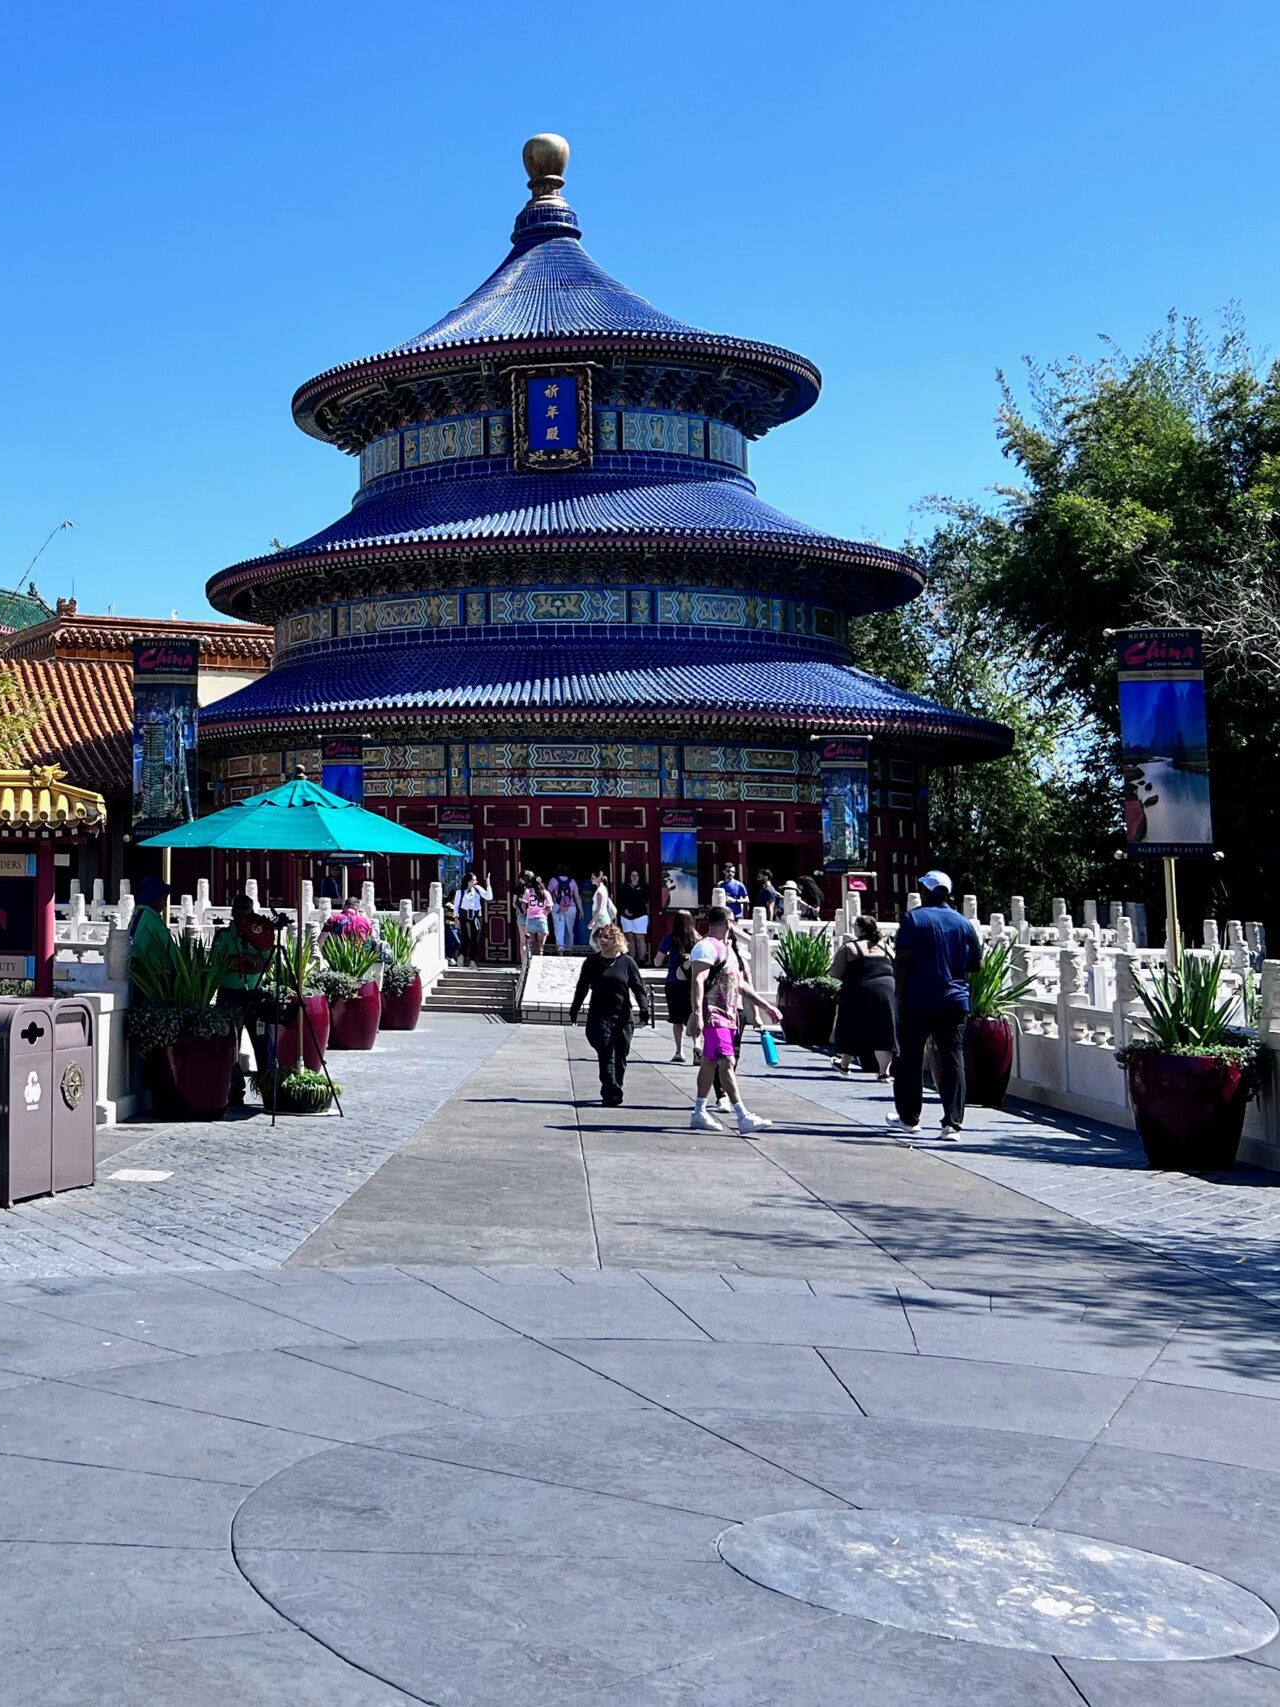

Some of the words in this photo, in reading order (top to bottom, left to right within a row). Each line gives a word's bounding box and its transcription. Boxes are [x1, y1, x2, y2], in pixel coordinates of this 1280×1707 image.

[543, 384, 561, 441] 祈年殿
[1128, 632, 1190, 640] REFLECTIONS
[138, 647, 193, 669] China
[1124, 640, 1194, 665] China
